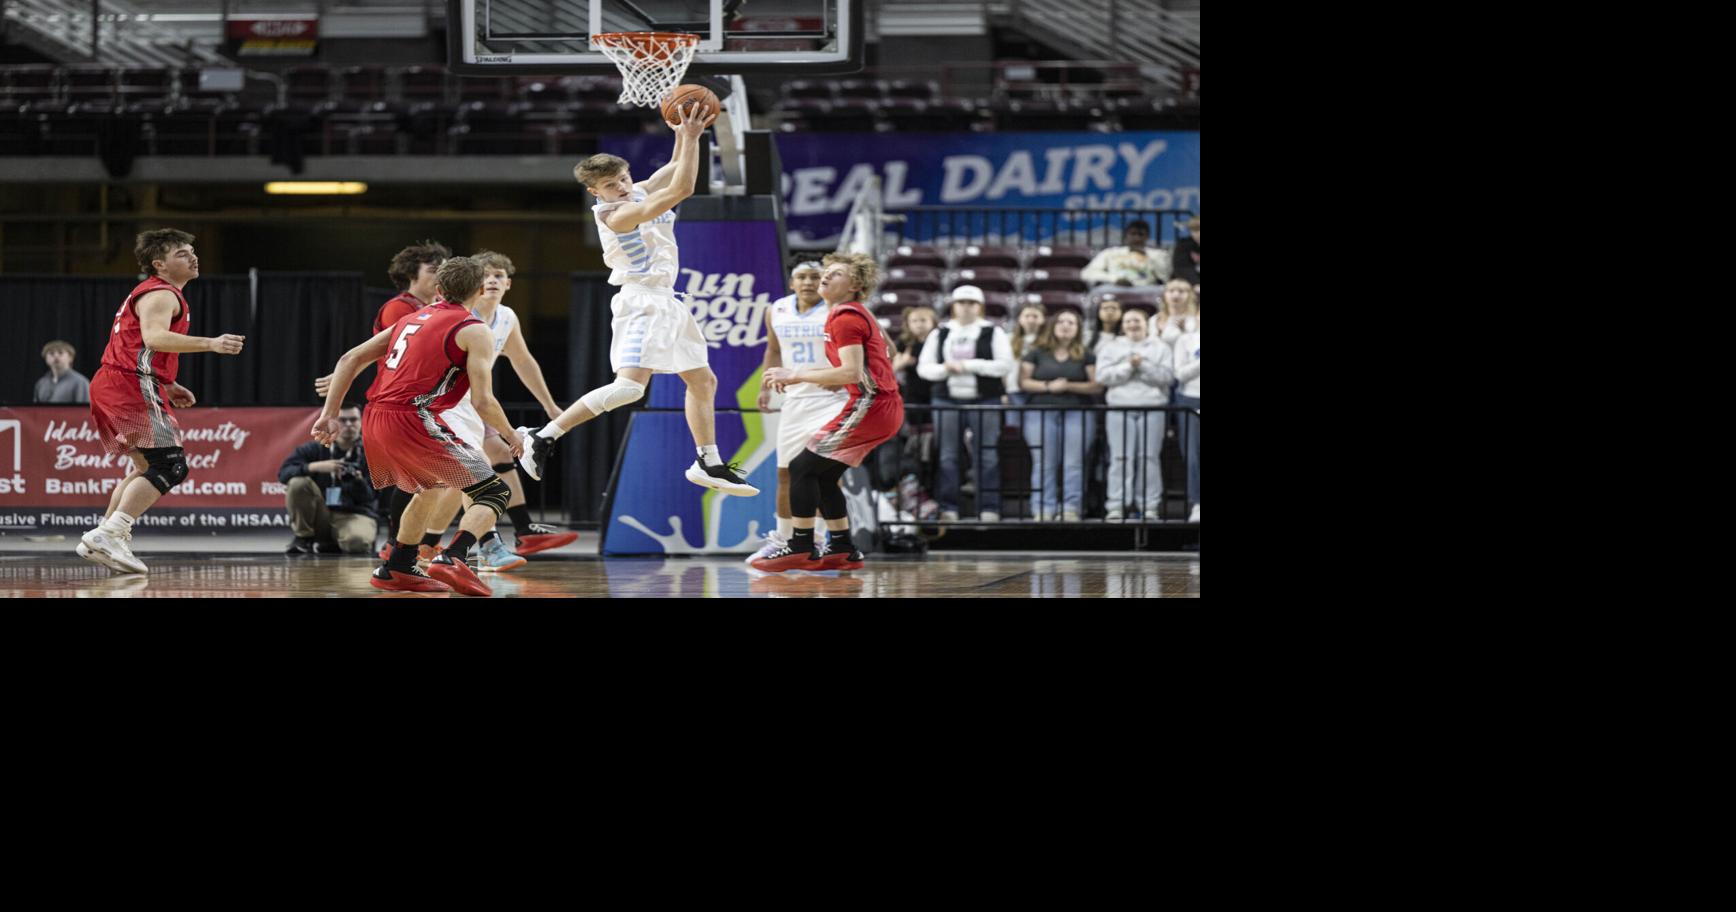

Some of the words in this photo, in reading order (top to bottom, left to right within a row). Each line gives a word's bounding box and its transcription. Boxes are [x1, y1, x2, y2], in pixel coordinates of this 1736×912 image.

[940, 139, 1167, 203] DAIRY
[1064, 187, 1200, 221] SHOOT
[680, 267, 755, 299] un
[684, 292, 773, 325] pott
[385, 323, 422, 371] 5
[791, 341, 815, 364] 21
[44, 420, 101, 442] Idah
[180, 421, 251, 450] unity
[54, 444, 115, 470] Bank
[180, 513, 196, 525] of
[199, 513, 226, 525] the
